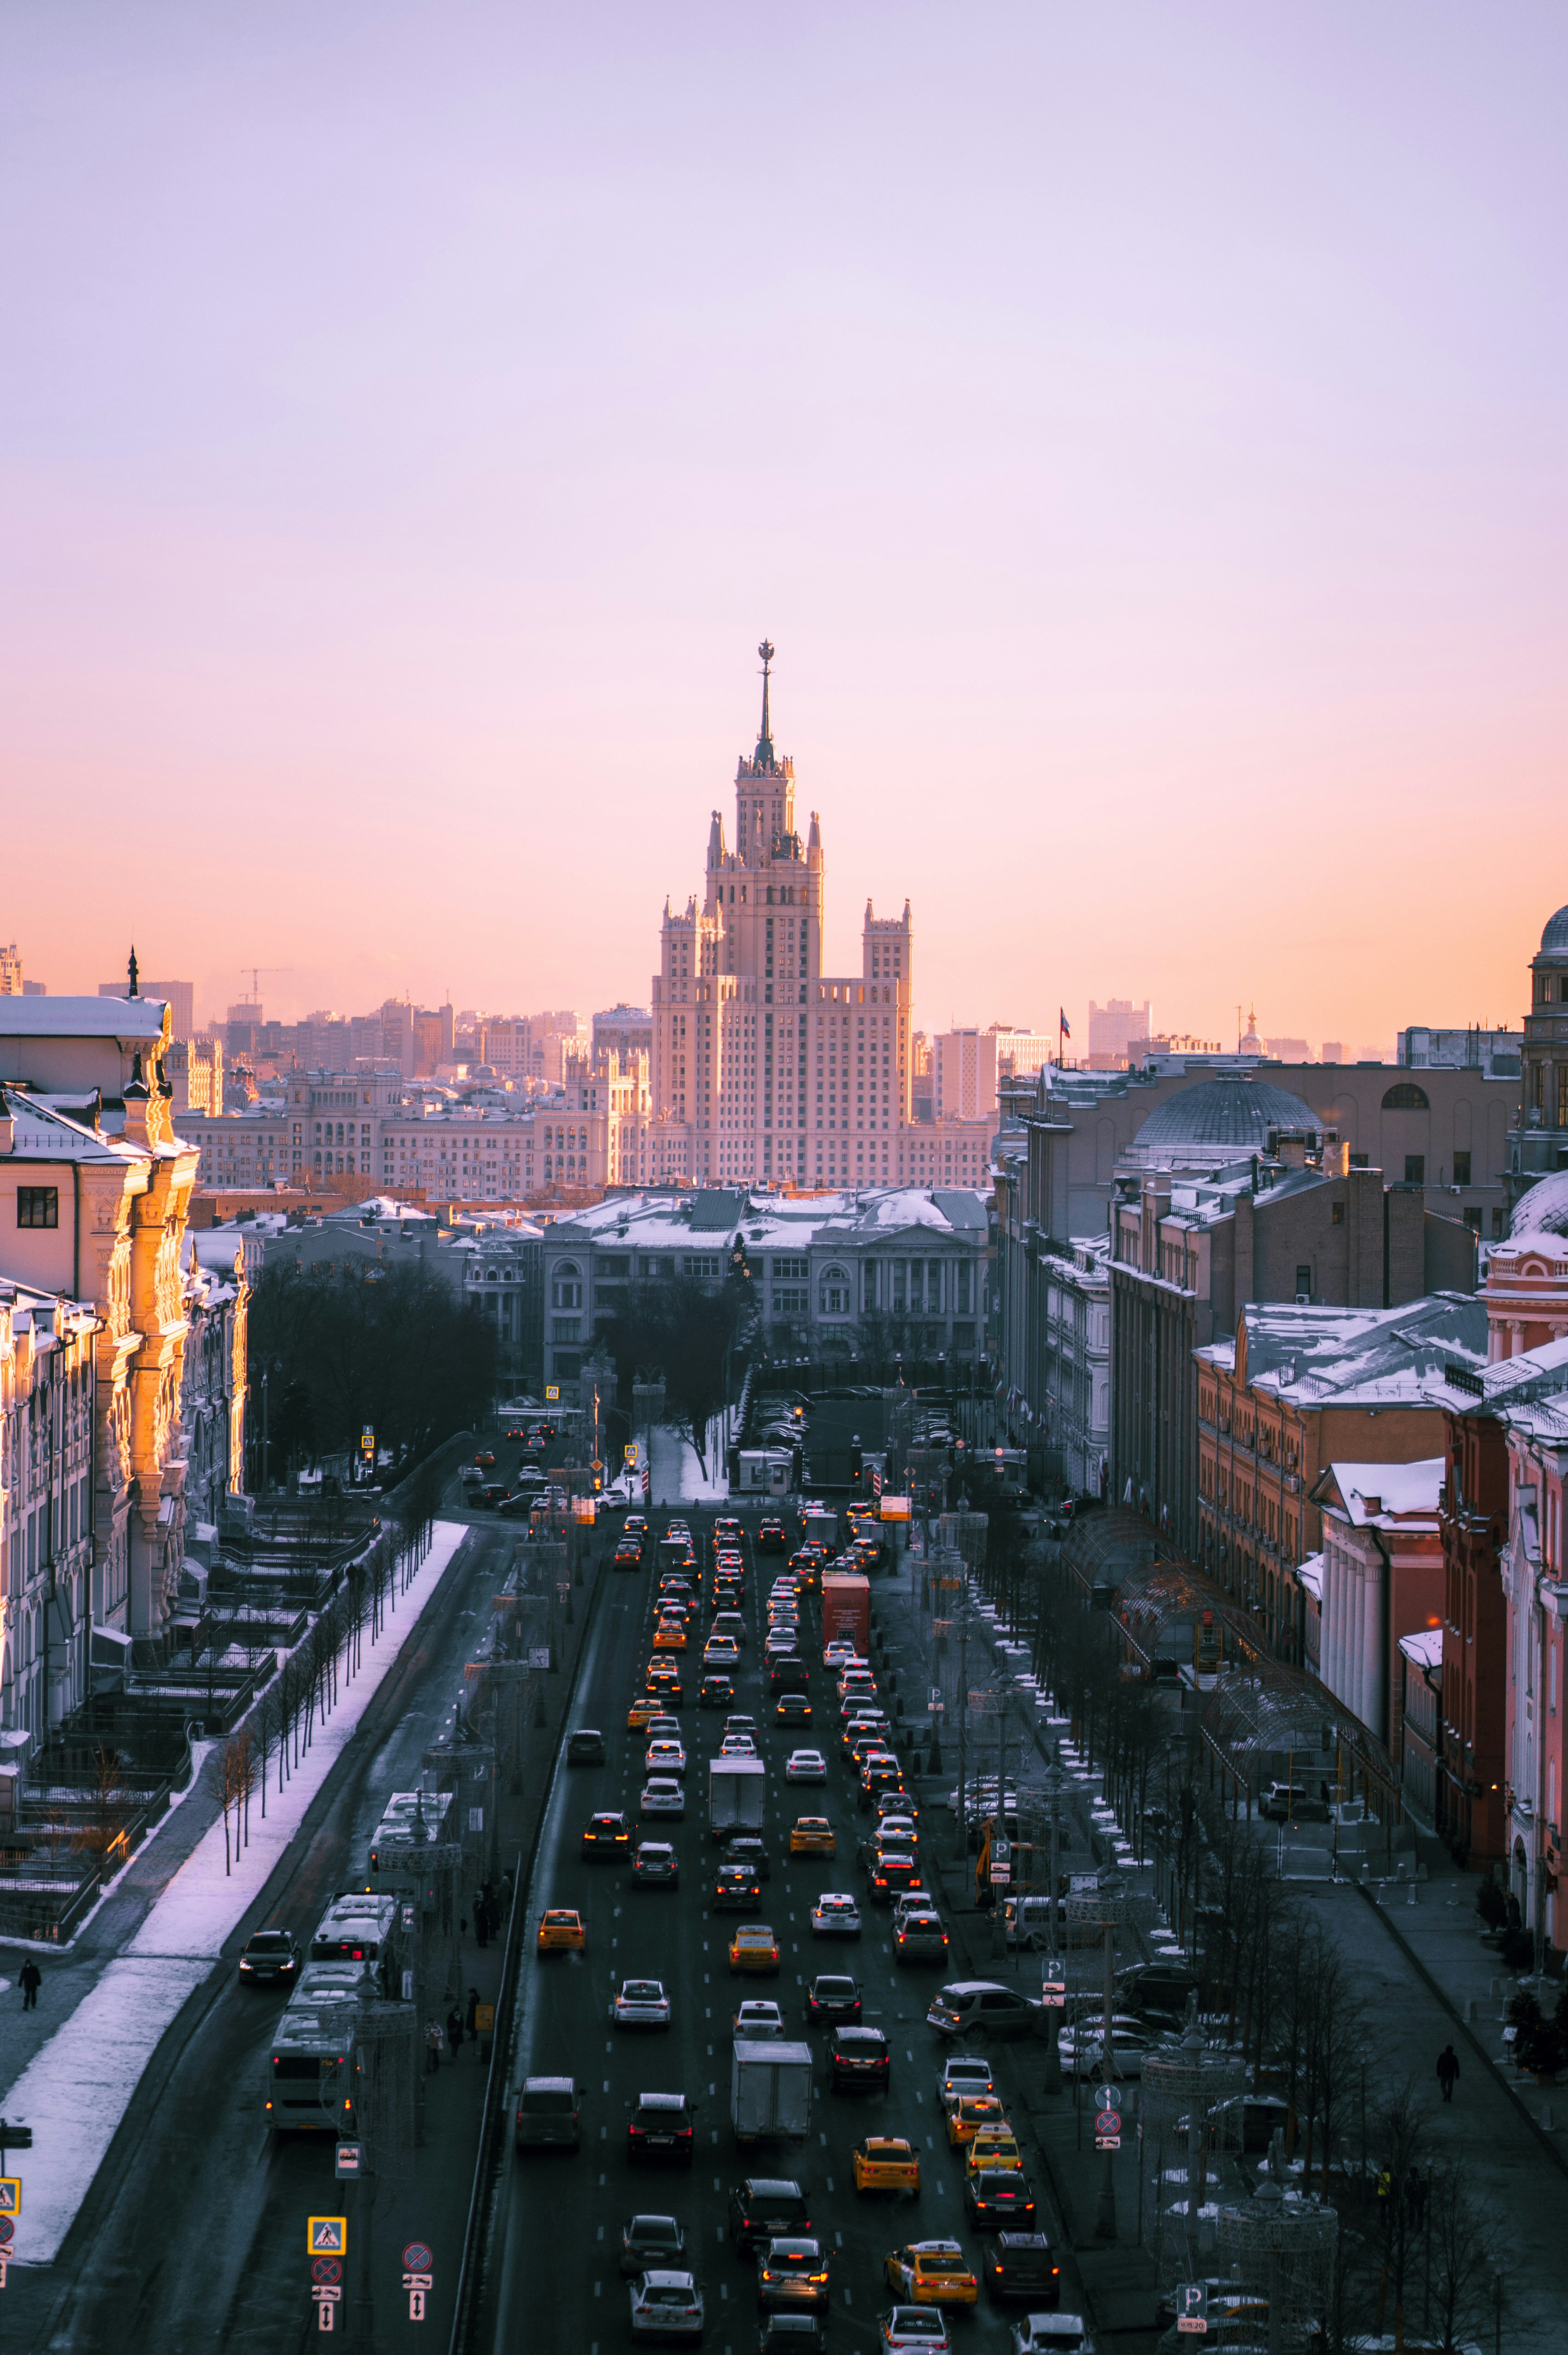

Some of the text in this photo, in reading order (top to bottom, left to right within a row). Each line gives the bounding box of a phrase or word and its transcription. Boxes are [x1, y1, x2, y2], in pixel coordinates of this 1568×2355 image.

[932, 1688, 940, 1701] P
[996, 1843, 1007, 1858] P
[1048, 1961, 1061, 1979] P
[1186, 2288, 1202, 2311] P
